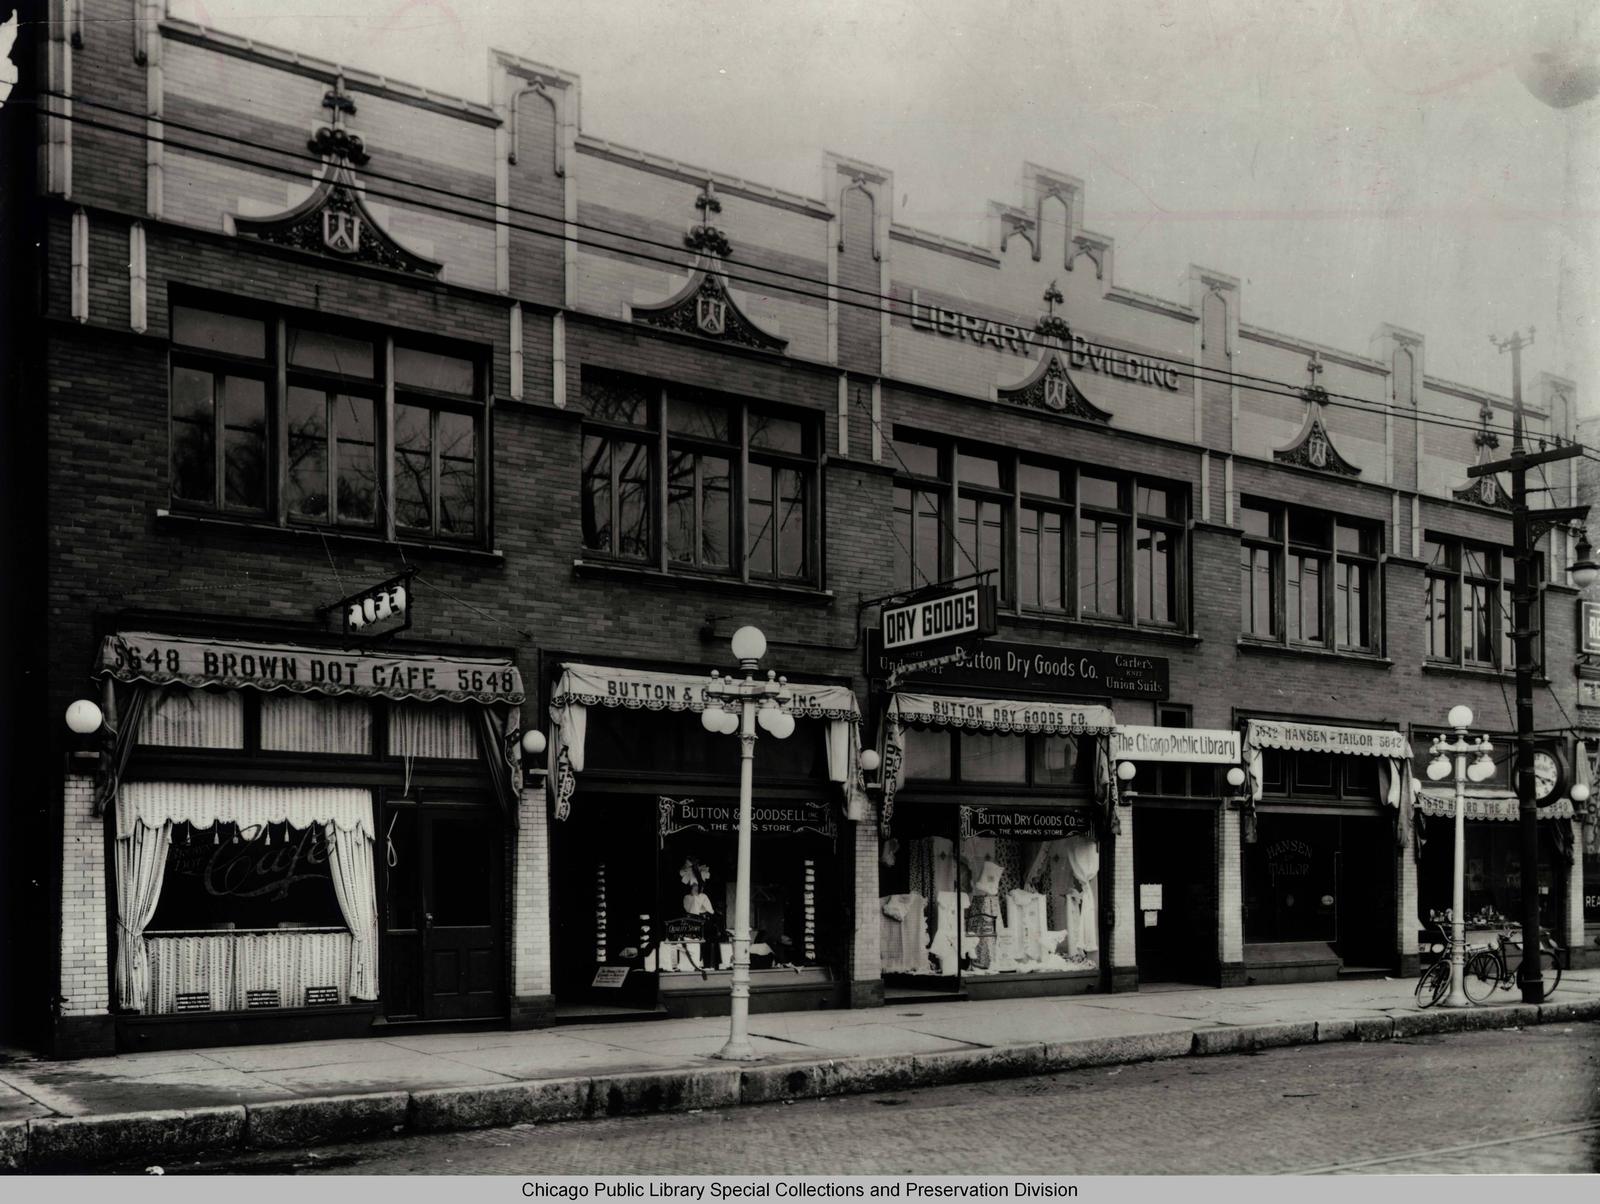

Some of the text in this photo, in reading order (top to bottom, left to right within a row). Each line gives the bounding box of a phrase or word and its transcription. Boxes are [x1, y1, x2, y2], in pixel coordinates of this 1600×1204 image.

[911, 288, 1035, 354] LIBRARY
[886, 595, 975, 645] DRY GOODS
[114, 644, 513, 692] 5648 BROWN DOT CAFE 5648
[1007, 651, 1030, 679] Dry
[1034, 654, 1075, 677] Goods
[1079, 657, 1099, 679] Co.
[607, 680, 676, 700] BUTTON
[683, 687, 693, 701] &
[792, 693, 821, 707] INC.
[1106, 676, 1162, 692] Union Suits
[932, 701, 1088, 725] BUTTON DRY GOODS CO.
[1117, 732, 1235, 760] The Chicago Public Library
[1285, 728, 1327, 743] HANSEN
[1338, 732, 1373, 747] TAILOR
[682, 805, 730, 820] BUTTON
[978, 812, 1012, 825] BUTTON
[1014, 813, 1032, 825] DRY
[1033, 814, 1062, 826] GOODS
[710, 823, 728, 831] THE
[761, 824, 792, 832] STORE
[1265, 840, 1313, 859] HANSEN
[1267, 863, 1310, 877] TAILOR
